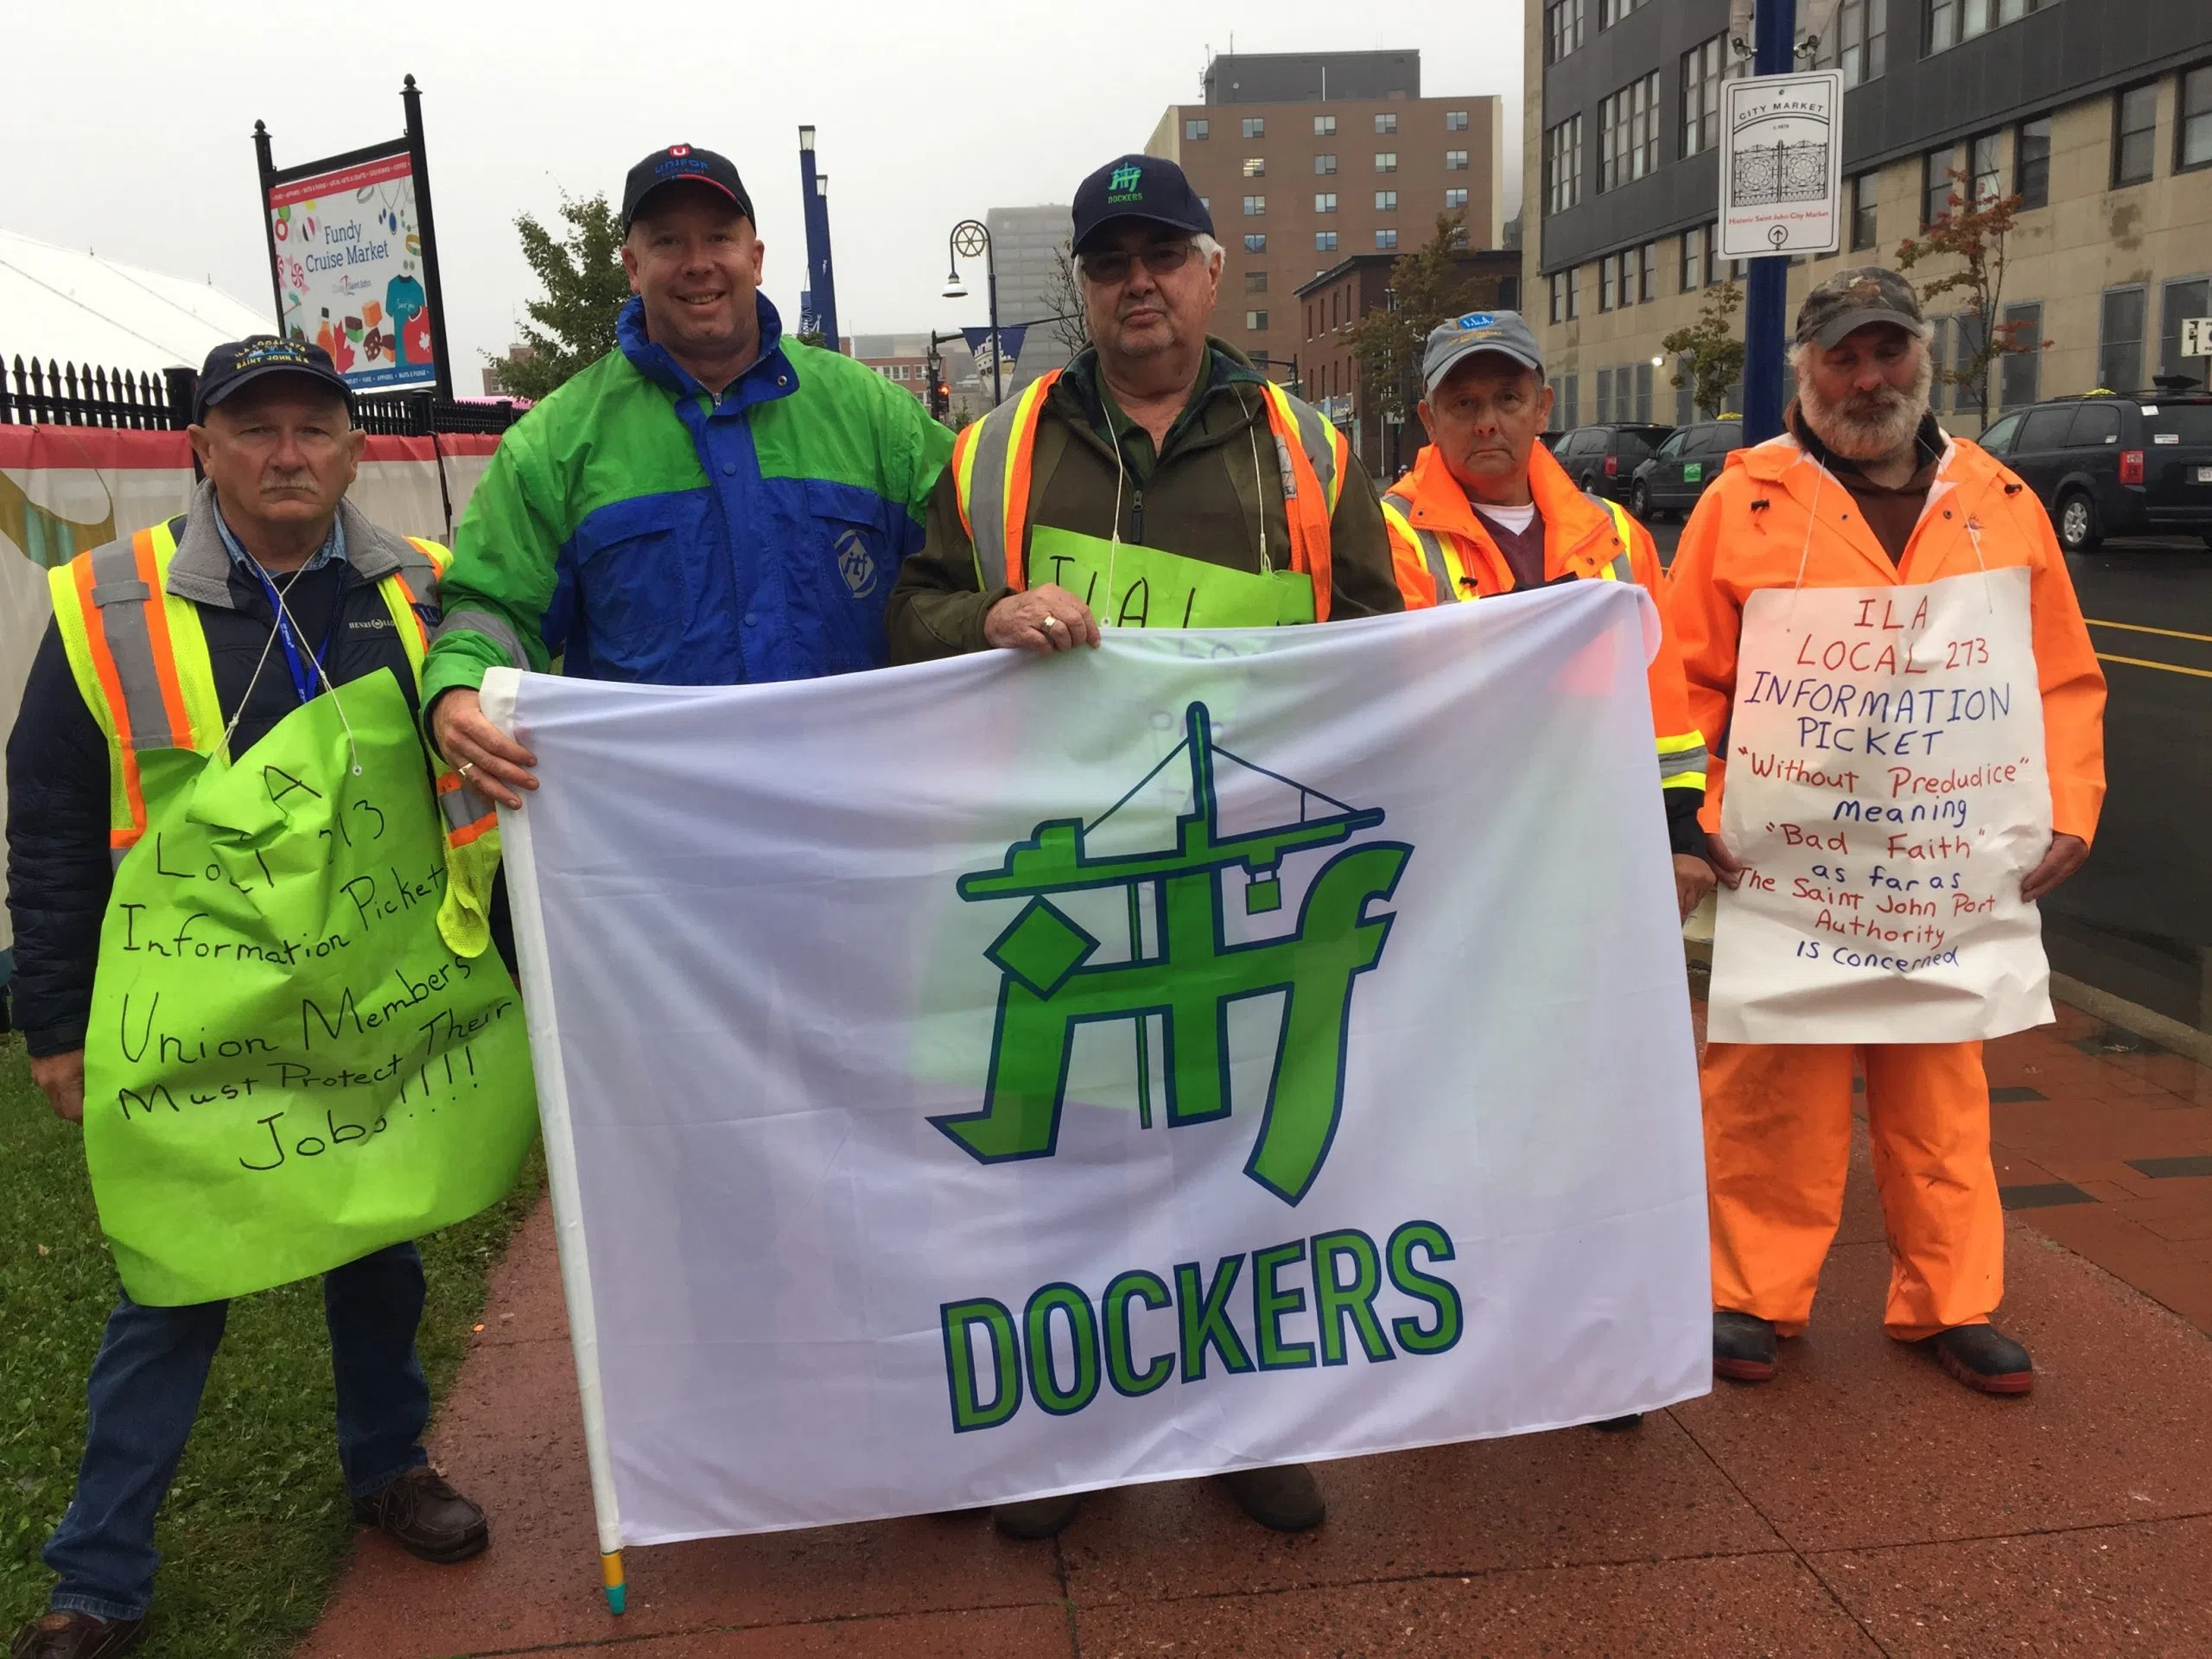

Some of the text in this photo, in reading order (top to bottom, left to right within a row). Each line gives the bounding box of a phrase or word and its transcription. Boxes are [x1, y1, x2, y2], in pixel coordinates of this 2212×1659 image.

[1739, 102, 1824, 120] CITY MARKET
[1108, 193, 1143, 204] DOCKERS
[1790, 212, 1804, 221] City
[324, 219, 362, 245] Fundy
[306, 240, 389, 272] Cruise Market
[236, 357, 262, 370] SAINT
[348, 620, 372, 629] HENRI
[1853, 595, 1928, 631] ILA
[1797, 633, 1989, 676] LOCAL 273
[1744, 671, 2011, 725] INFORMATION
[1797, 716, 1944, 758] PICKET
[1738, 867, 1995, 918] The Saint John Port
[1811, 865, 1847, 883] as
[119, 868, 443, 965] Information Picket
[1815, 908, 1945, 950] Authority
[120, 956, 472, 1064] Union Members
[118, 1001, 512, 1121] Must Protect Their
[939, 1219, 1465, 1434] DOCKERS
